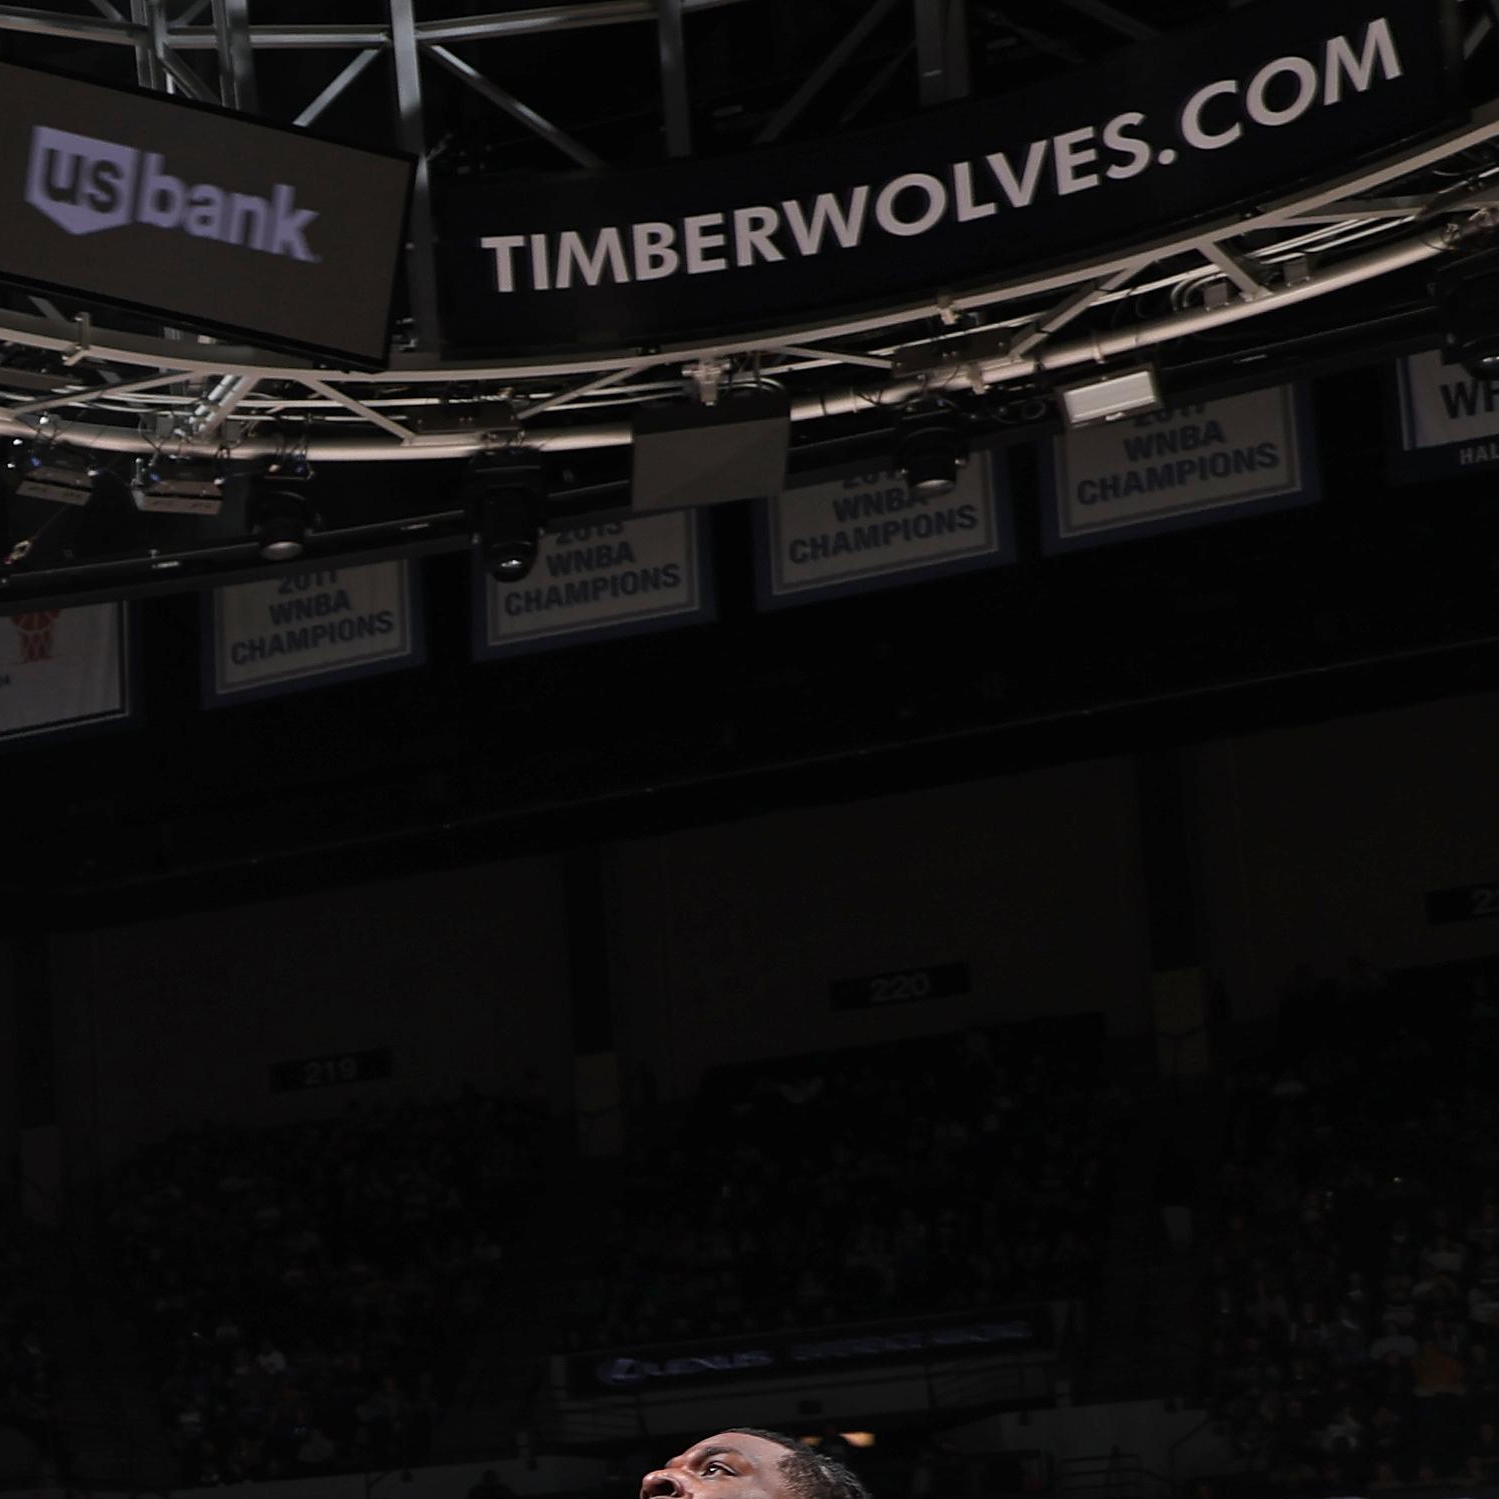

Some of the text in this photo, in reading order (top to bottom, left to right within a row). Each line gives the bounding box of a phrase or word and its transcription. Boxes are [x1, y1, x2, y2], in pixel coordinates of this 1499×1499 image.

[481, 17, 1403, 293] TIMBERWOLVES.COM
[1124, 420, 1224, 462] WNBA
[1076, 442, 1280, 507] CHAMPIONS
[833, 485, 927, 522] WNBA
[788, 505, 978, 566] CHAMPIONS
[546, 539, 633, 578] WNBA
[269, 589, 351, 627] WNBA
[503, 563, 681, 617] CHAMPIONS
[230, 609, 395, 667] CHAMPIONS
[870, 973, 931, 1001] 220
[304, 1055, 360, 1087] 219
